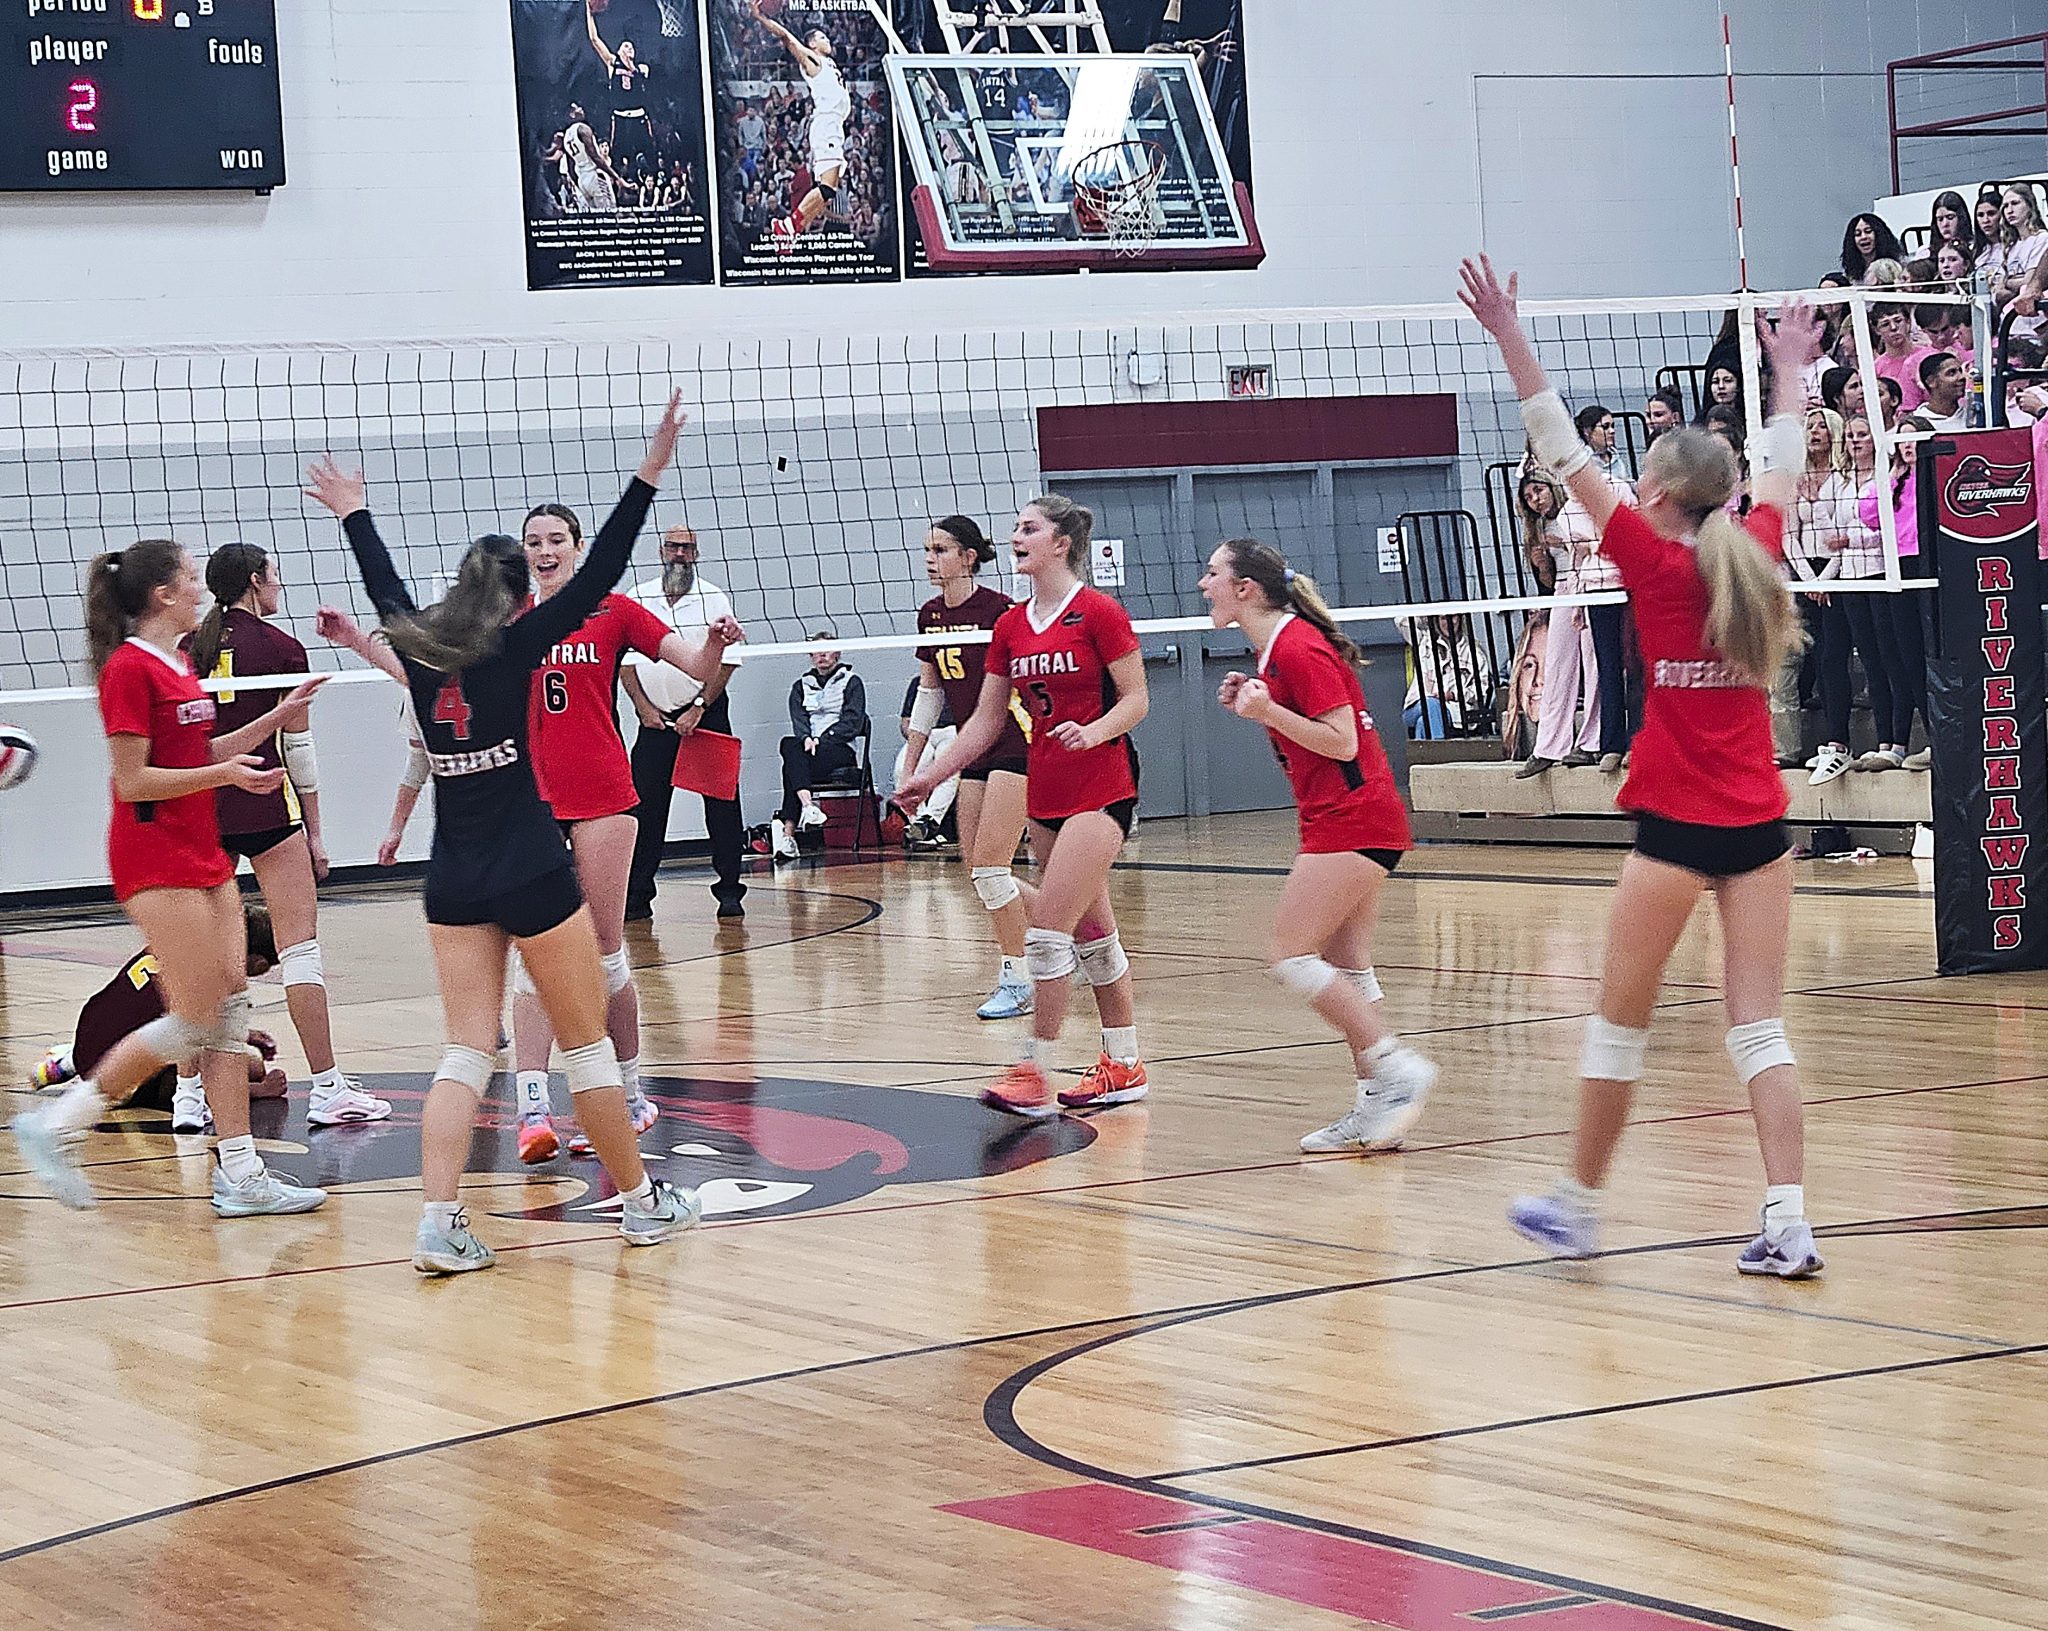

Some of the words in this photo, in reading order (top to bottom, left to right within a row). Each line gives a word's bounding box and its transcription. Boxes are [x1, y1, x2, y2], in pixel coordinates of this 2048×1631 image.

[789, 0, 810, 11] MR.
[812, 0, 869, 11] BASKETBA
[30, 35, 108, 65] player
[209, 39, 262, 64] fouls
[68, 81, 97, 131] 2
[984, 88, 1006, 108] 14
[47, 150, 108, 175] game
[220, 151, 263, 168] won
[1230, 369, 1267, 395] EXIT
[1956, 487, 2027, 501] RIVERHAWKS
[541, 642, 600, 666] TRAL
[935, 647, 966, 680] 15
[1010, 651, 1080, 679] ENTRAL
[543, 670, 569, 714] 6
[1026, 681, 1054, 718] 5
[433, 676, 472, 740] 4
[1976, 556, 2030, 951] RIVERHAWKS
